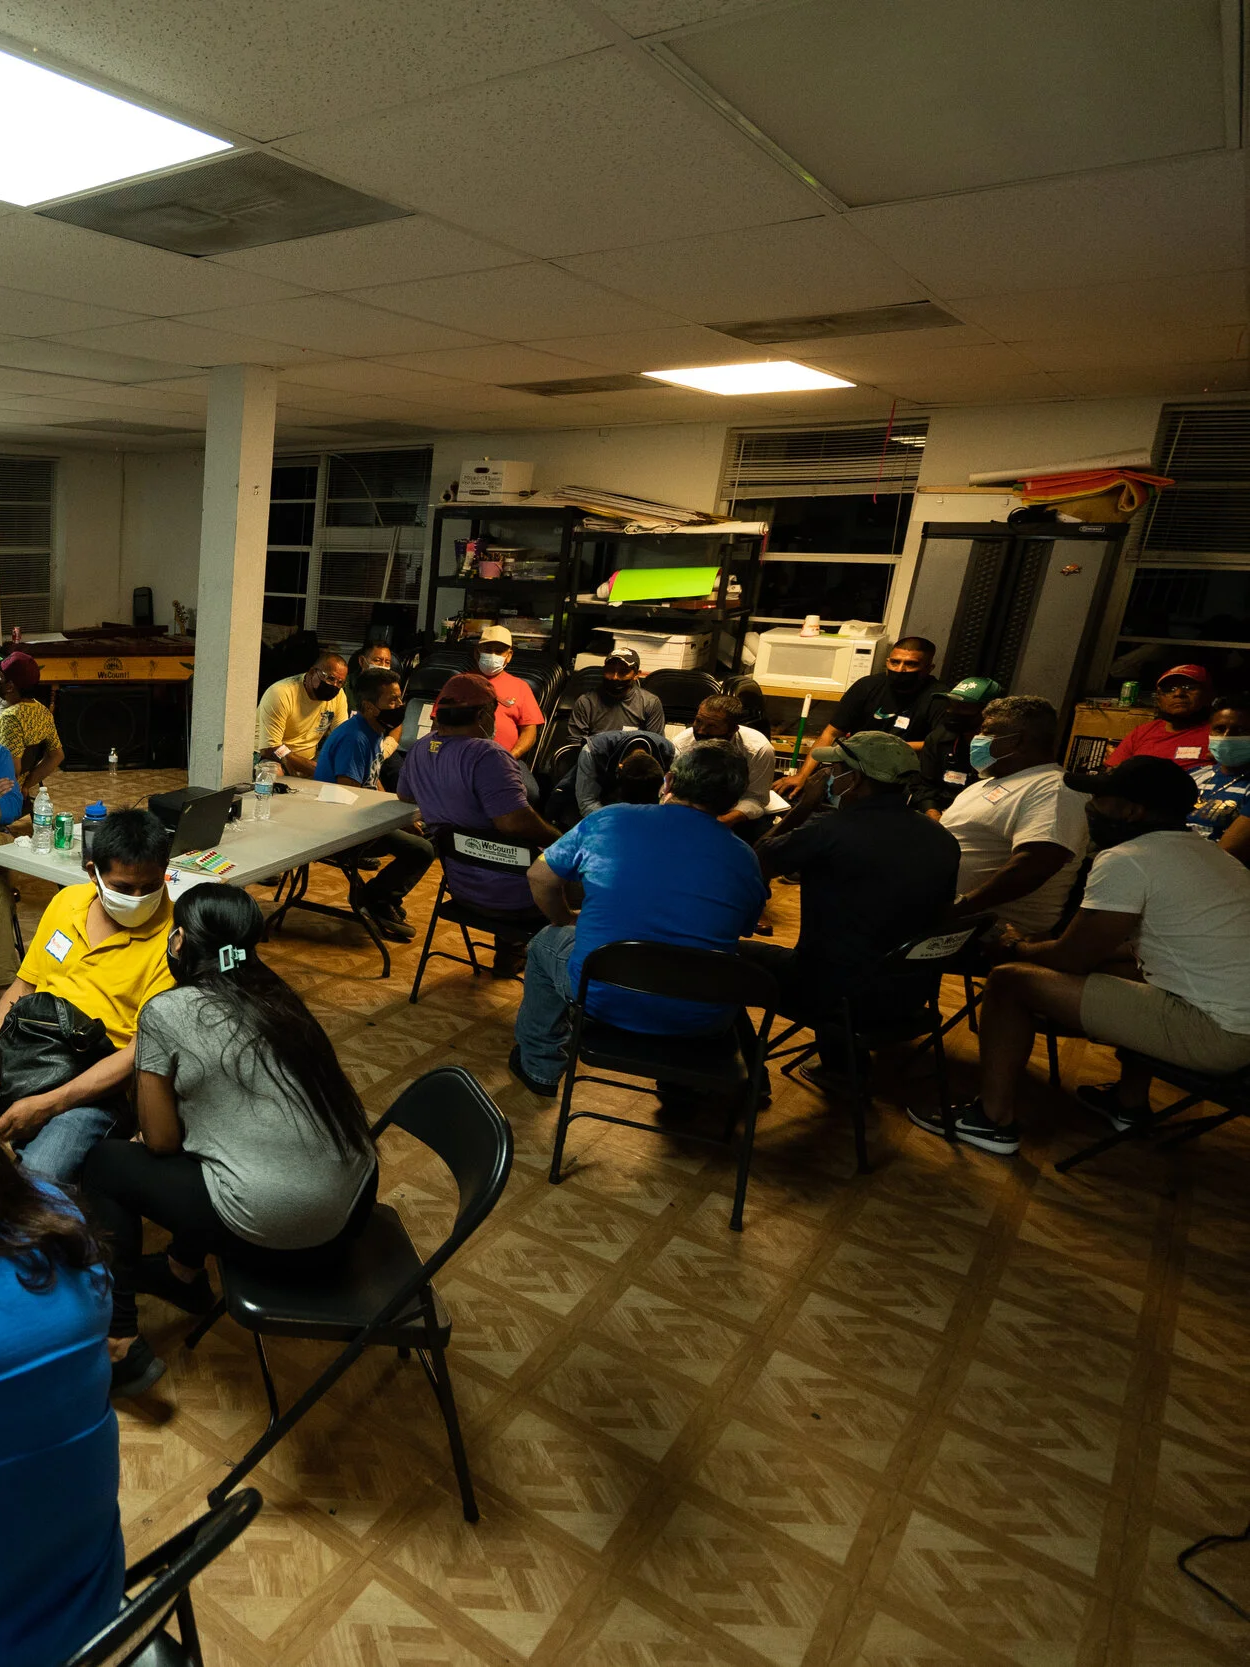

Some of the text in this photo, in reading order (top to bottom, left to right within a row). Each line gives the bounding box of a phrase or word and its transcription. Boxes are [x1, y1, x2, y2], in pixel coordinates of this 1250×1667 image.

[97, 671, 130, 679] WeCount!
[481, 840, 518, 855] WeCount!
[464, 849, 519, 864] www.we-count.org
